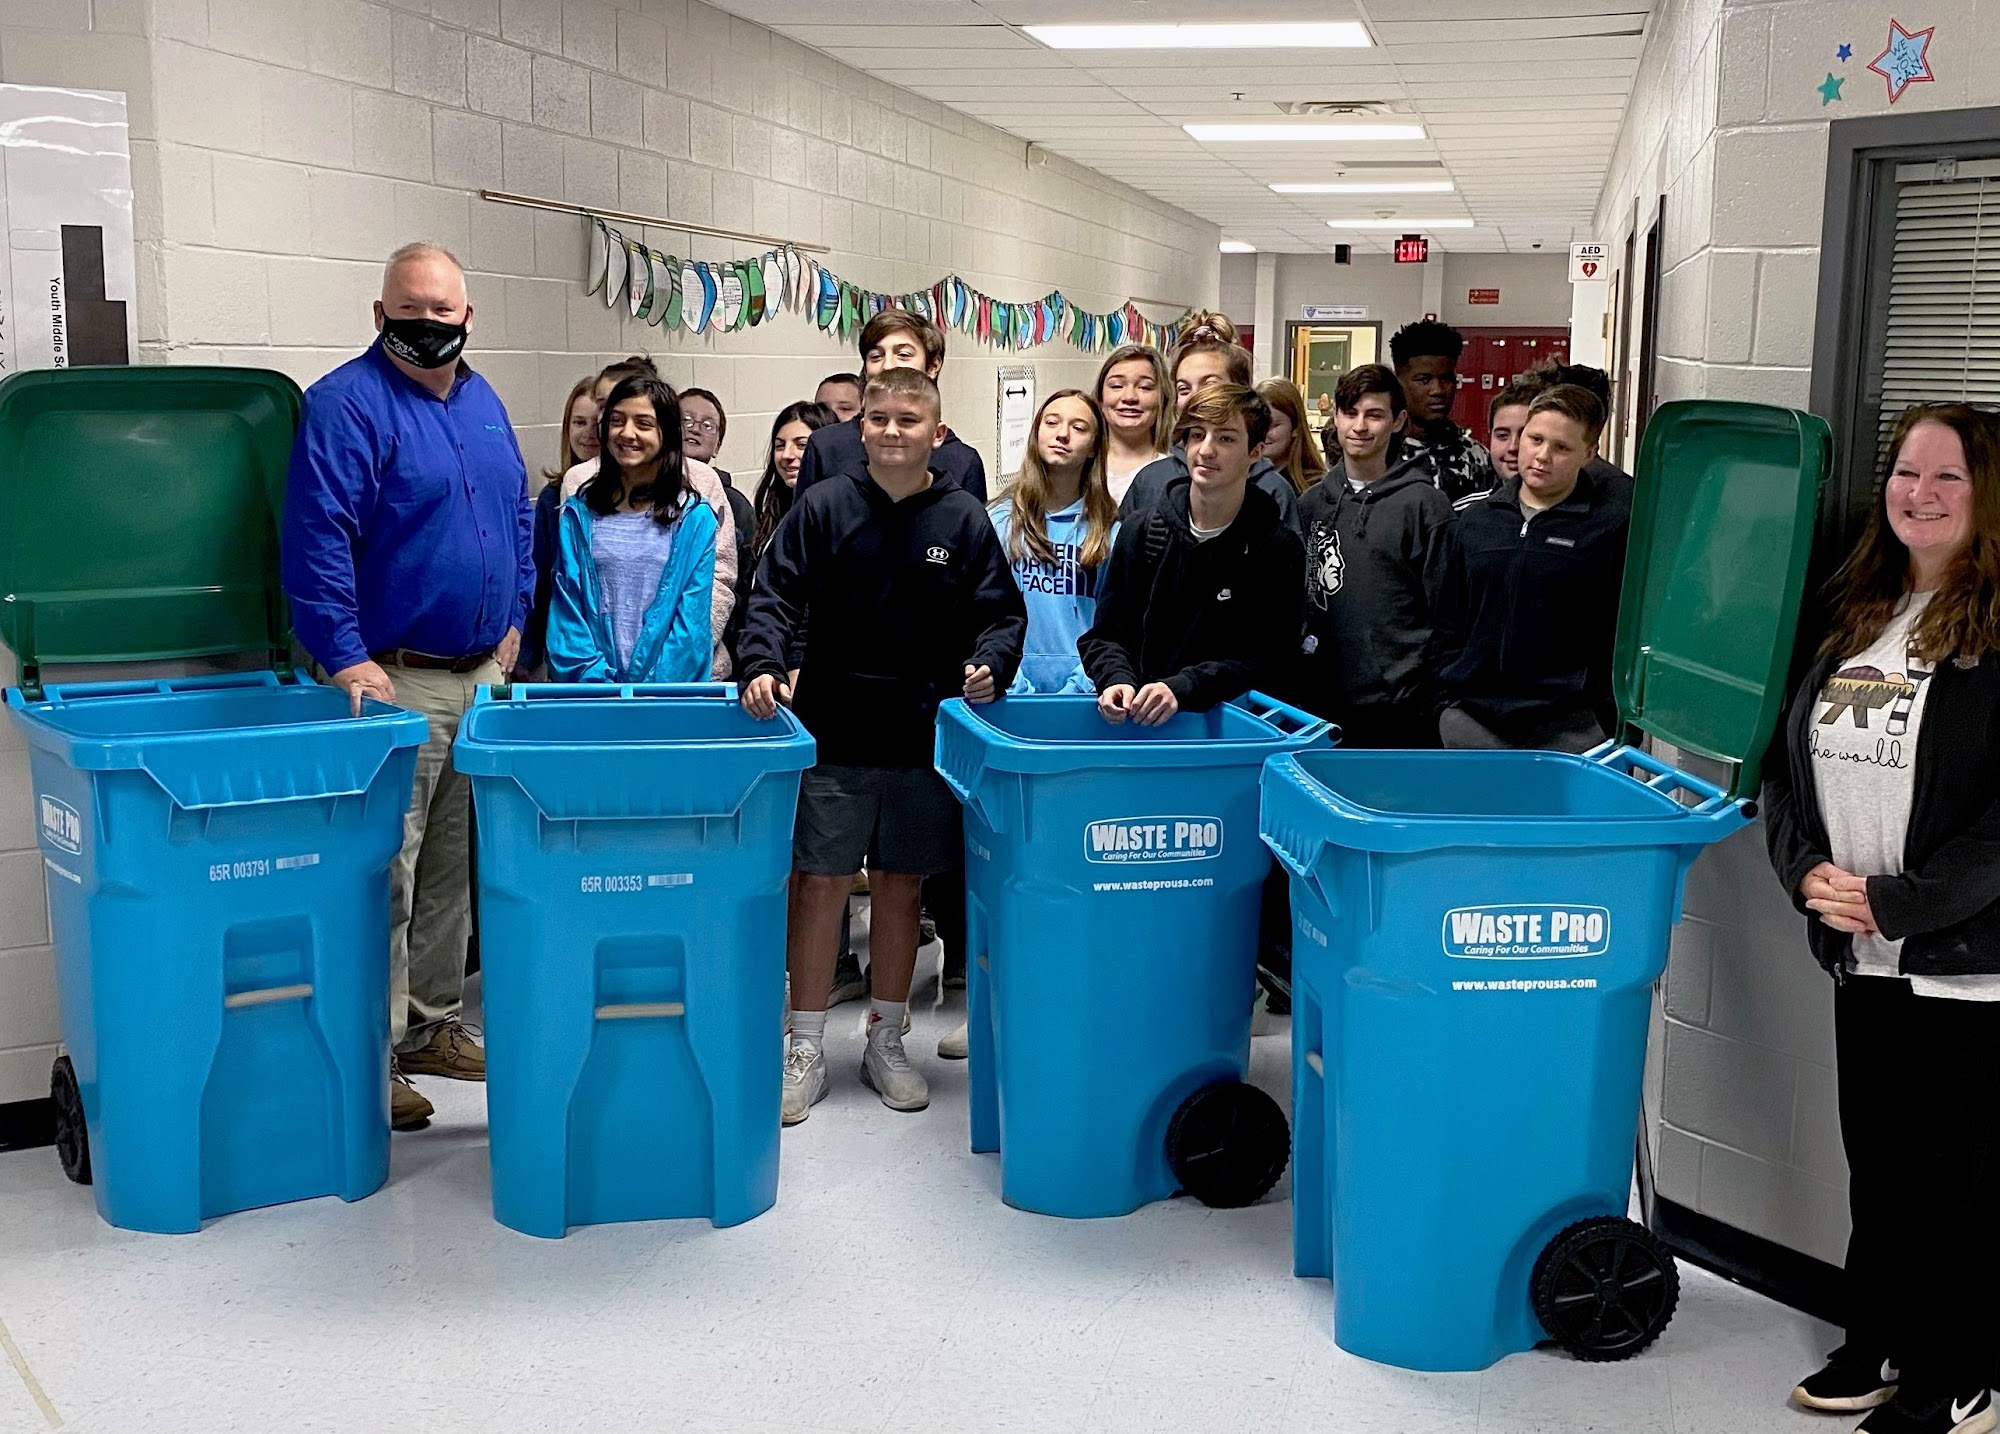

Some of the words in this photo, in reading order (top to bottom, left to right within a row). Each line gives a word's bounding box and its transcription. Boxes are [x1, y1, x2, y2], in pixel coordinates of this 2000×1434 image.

[1891, 49, 1917, 74] YOU
[1399, 241, 1424, 261] EXIT
[1581, 246, 1601, 254] AED
[50, 277, 61, 311] Youth
[52, 314, 63, 353] Middle
[1838, 738, 1908, 769] world
[1091, 824, 1167, 851] WASTE
[1174, 821, 1217, 848] PRO
[1102, 851, 1127, 861] Caring
[1128, 850, 1141, 860] For
[1142, 850, 1157, 859] Our
[1157, 848, 1206, 858] Communities
[209, 864, 231, 881] 65R
[233, 859, 270, 879] 003791
[581, 876, 602, 892] 65R
[604, 875, 642, 892] 003353
[1093, 878, 1214, 891] www.wasteprousa.com
[1451, 912, 1542, 944] WASTE
[1550, 911, 1603, 943] PRO
[1464, 945, 1494, 956] Caring
[1495, 944, 1511, 955] For
[1512, 944, 1529, 954] Our
[1530, 943, 1588, 954] Communities
[1452, 978, 1597, 992] www.wasteprousa.com
